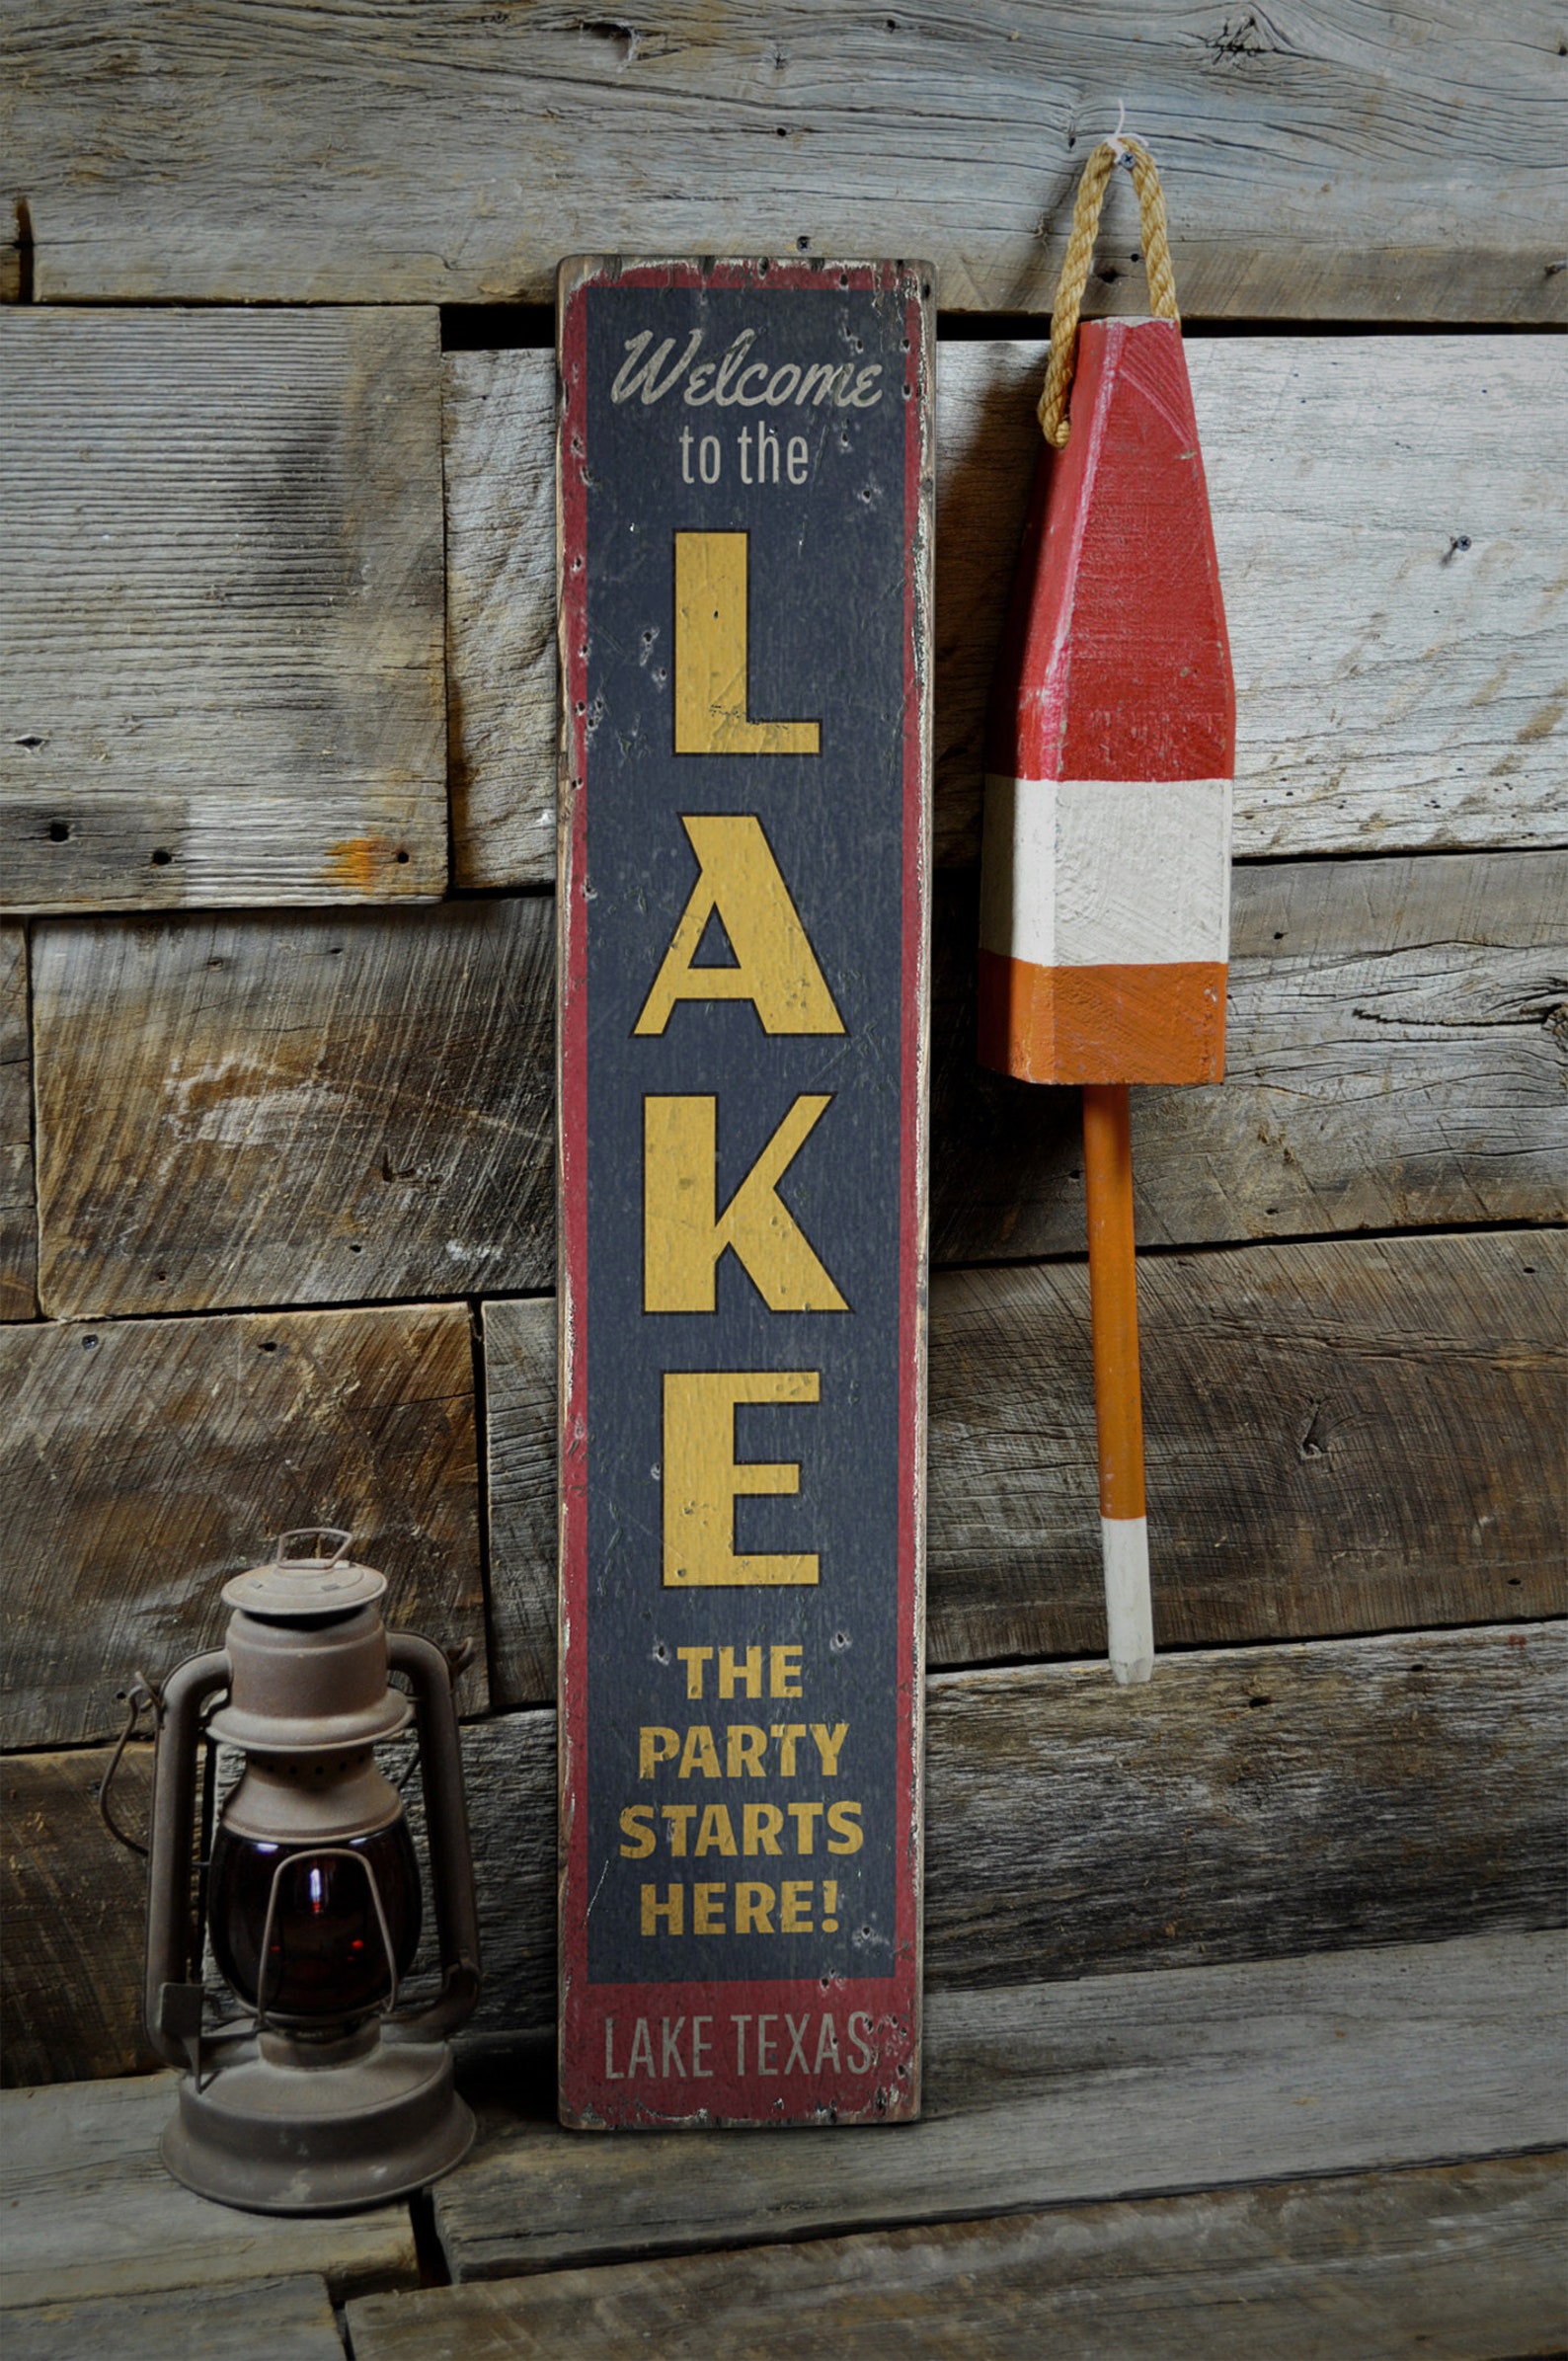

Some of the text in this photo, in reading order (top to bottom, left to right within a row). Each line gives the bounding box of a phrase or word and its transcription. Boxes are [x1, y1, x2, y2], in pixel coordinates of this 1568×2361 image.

[610, 327, 883, 408] Welcome
[678, 421, 809, 485] to the
[632, 528, 854, 1588] LAKE
[676, 1645, 803, 1699] THE
[639, 1722, 849, 1779] PARTY
[618, 1800, 864, 1859] STARTS
[640, 1880, 839, 1936] HERE!
[604, 2010, 873, 2080] LAKE TEXAS
